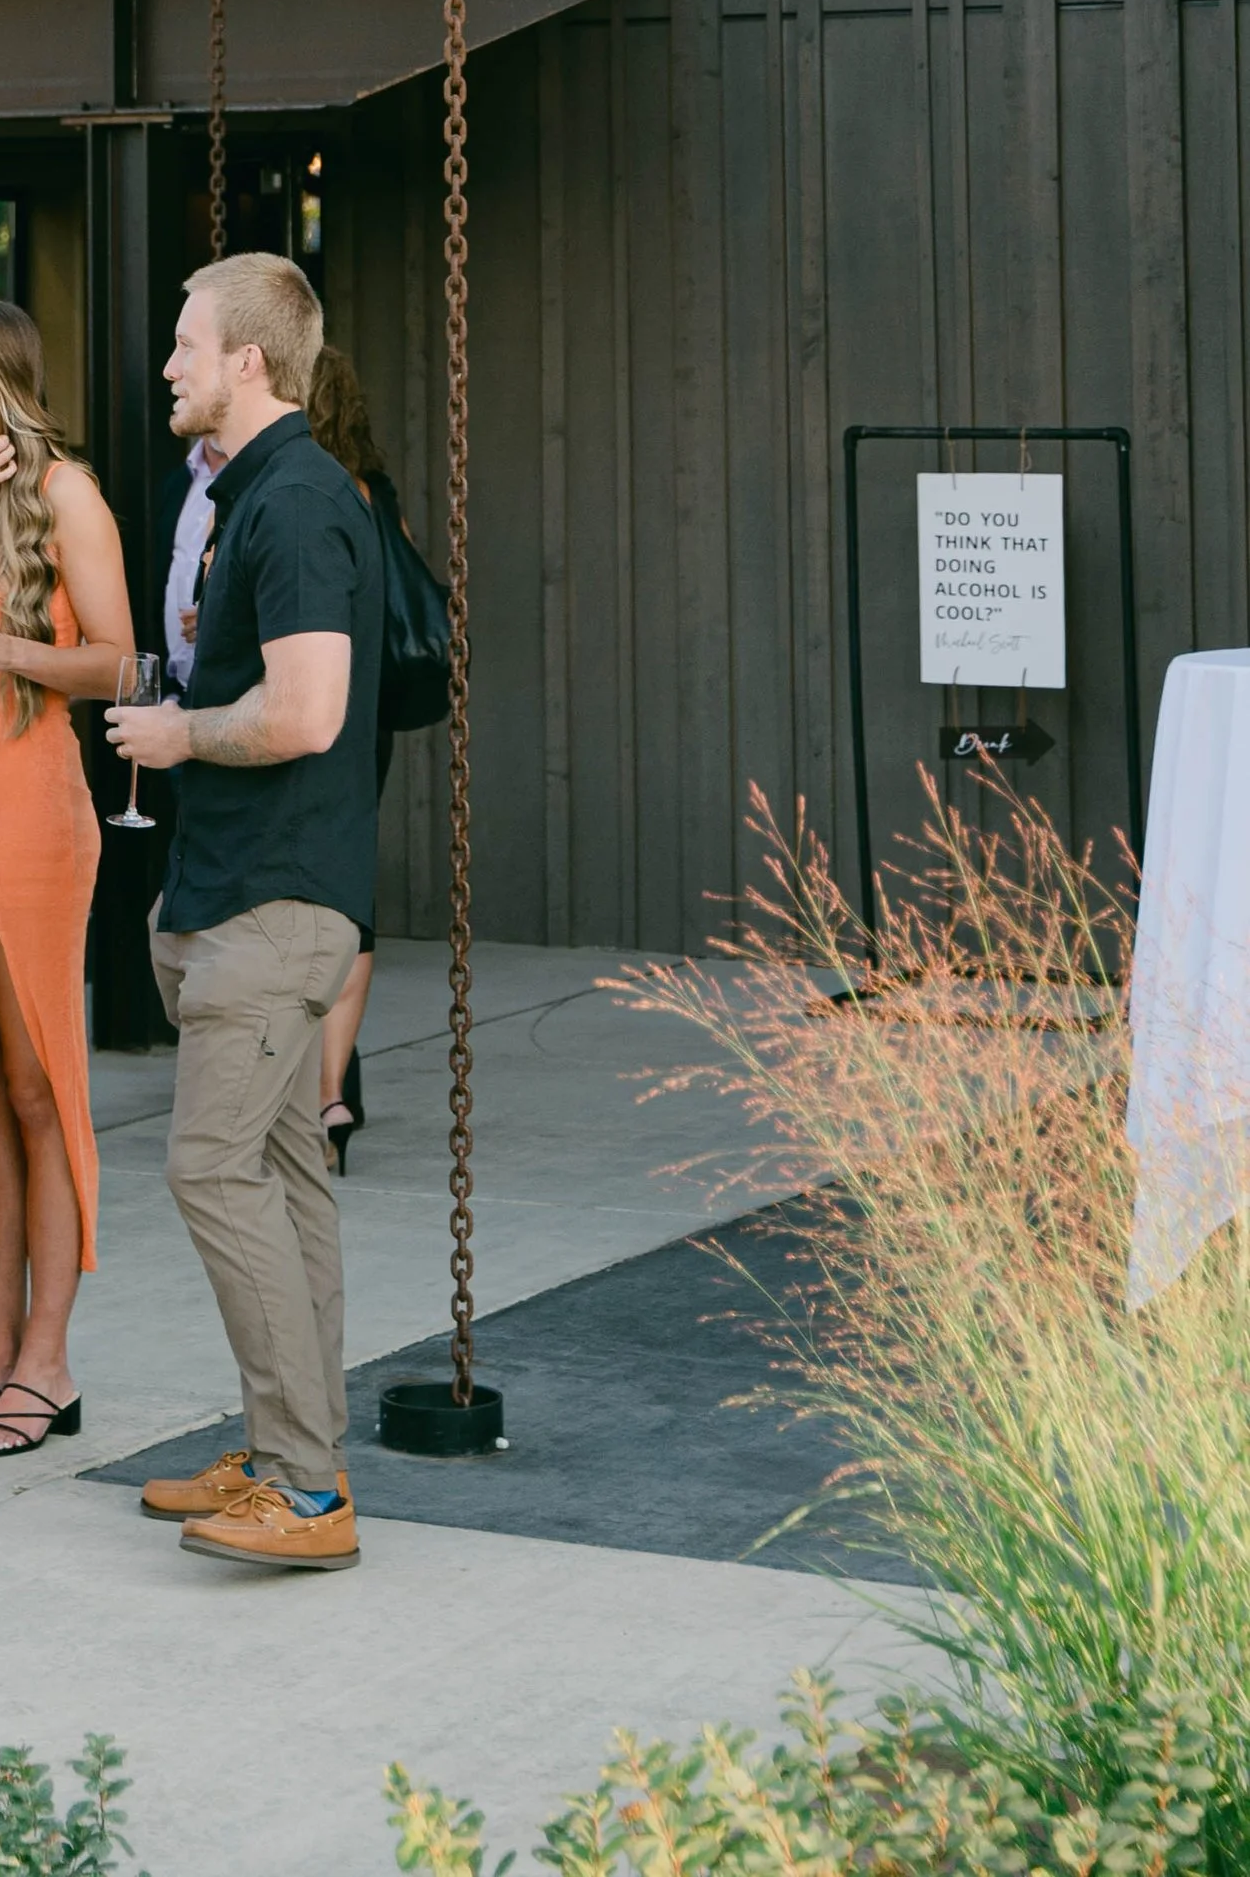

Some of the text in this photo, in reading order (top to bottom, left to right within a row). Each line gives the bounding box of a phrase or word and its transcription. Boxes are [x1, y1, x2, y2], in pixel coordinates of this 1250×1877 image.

[980, 512, 1019, 527] YOU
[935, 535, 1048, 552] THINK THAT
[935, 558, 996, 574] DOING
[935, 582, 1047, 599] ALCOHOL IS
[954, 732, 1012, 756] Dink
